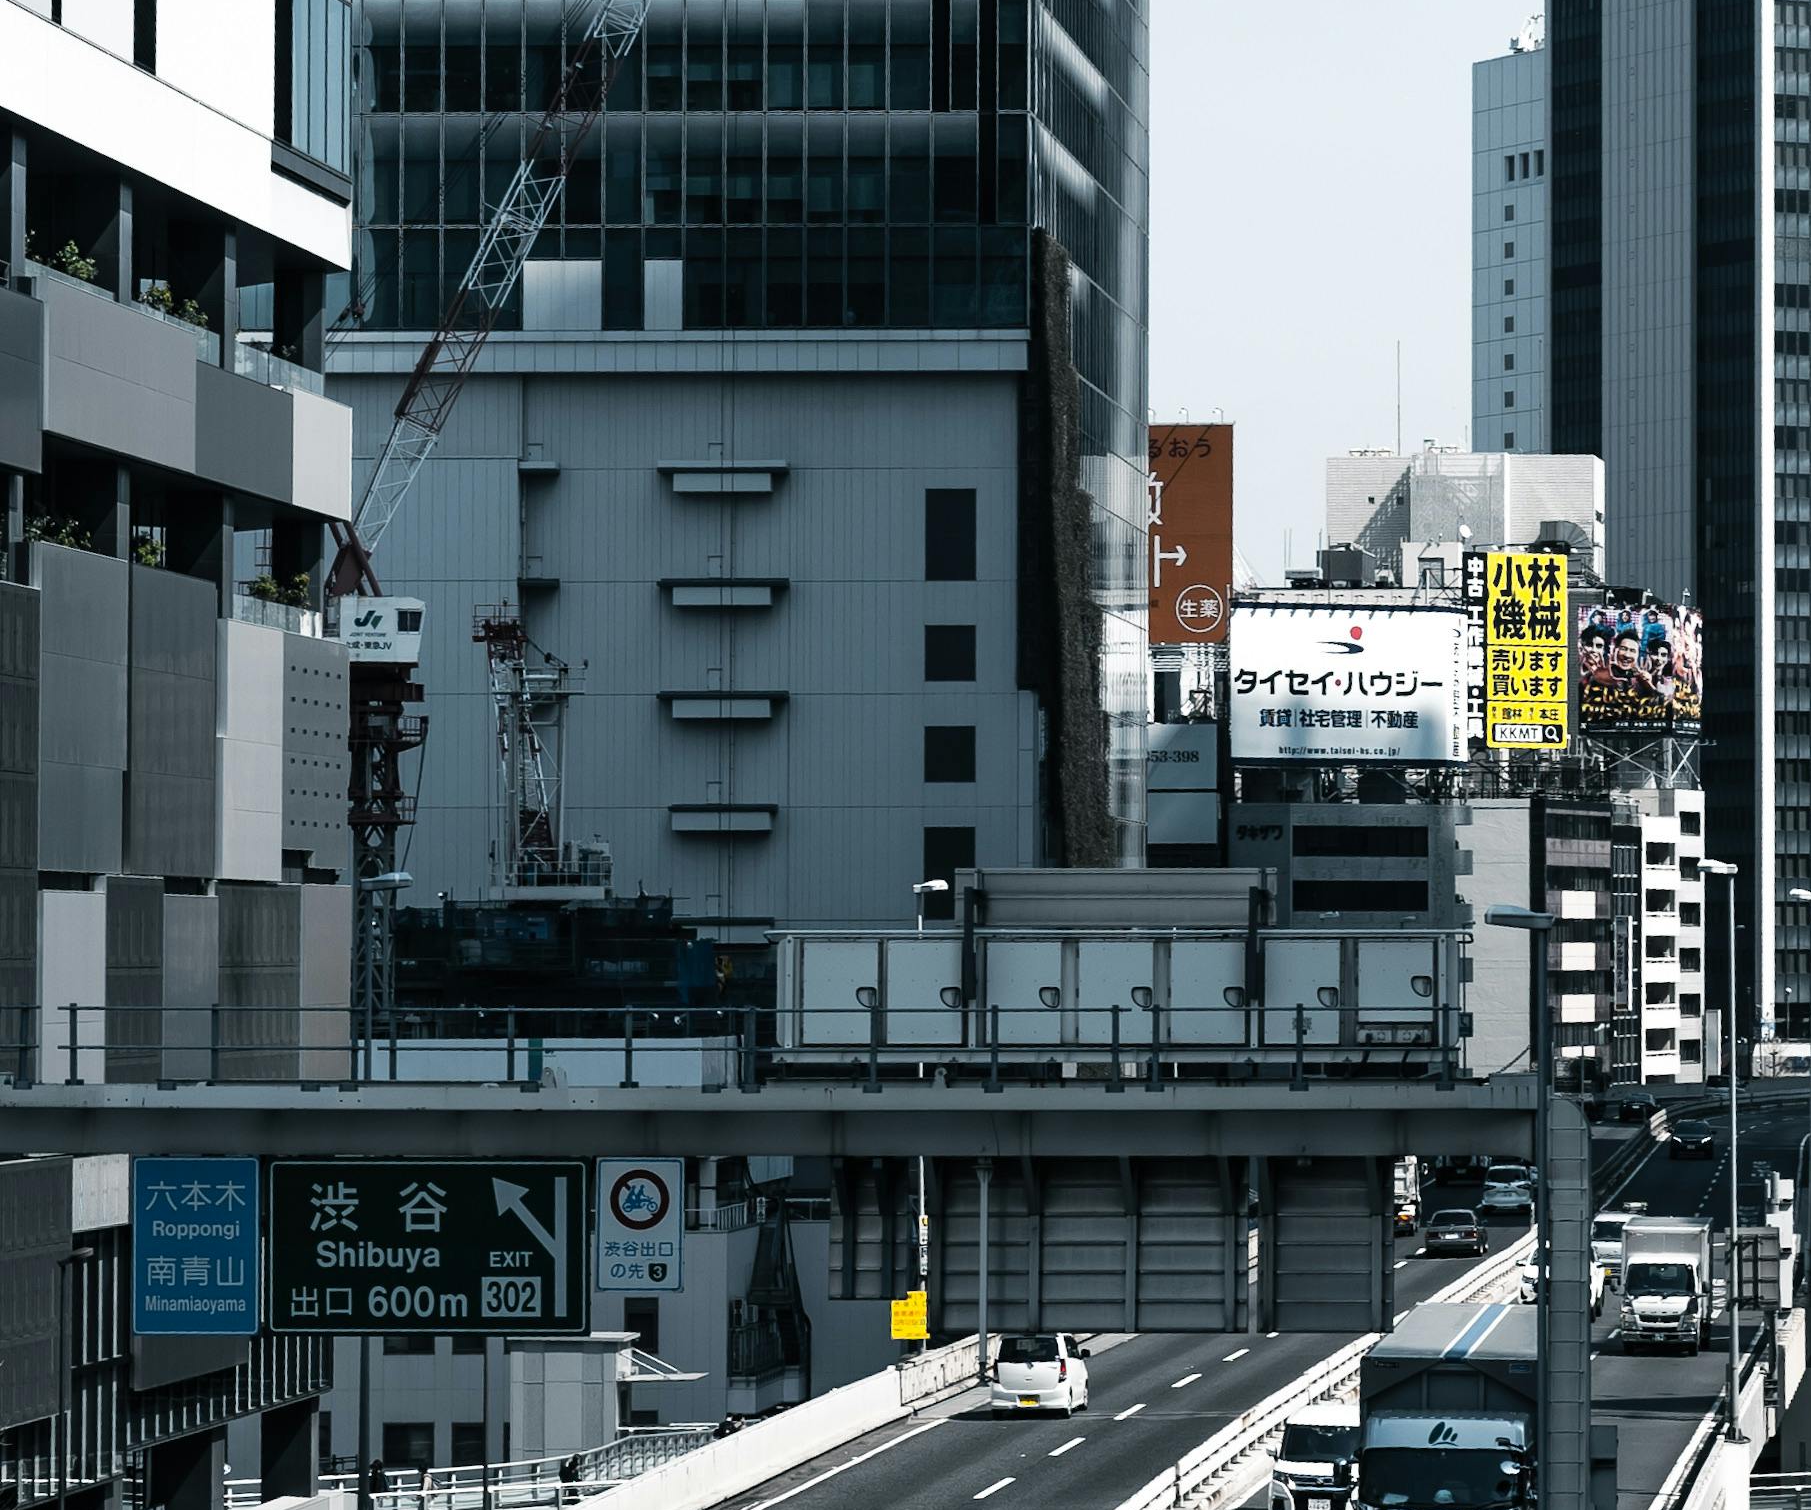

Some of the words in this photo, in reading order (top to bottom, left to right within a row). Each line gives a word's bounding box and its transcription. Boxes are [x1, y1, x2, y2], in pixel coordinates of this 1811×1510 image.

[1493, 557, 1561, 598] 小林
[1180, 599, 1219, 618] 生薬
[1493, 598, 1561, 641] 機械
[1492, 649, 1562, 672] 売ります
[1234, 668, 1443, 697] タイセイ・ハウジー
[1492, 675, 1562, 697] 買います
[1259, 709, 1292, 728] 賃貸
[1299, 709, 1362, 728] 社宅管理
[1371, 710, 1419, 729] 不動産
[1500, 728, 1538, 739] KKMT
[146, 1181, 245, 1212] 六本木
[310, 1181, 448, 1232] 渋谷
[152, 1220, 240, 1240] Roppongi
[316, 1241, 441, 1274] Shibuya
[490, 1251, 533, 1268] EXIT
[604, 1241, 674, 1258] 渋谷出口
[146, 1256, 244, 1287] 南青山
[610, 1262, 645, 1279] の先
[145, 1295, 246, 1315] Minamiaoyama
[291, 1287, 353, 1317] 出口
[368, 1286, 468, 1318] 600m
[486, 1281, 537, 1313] 302
